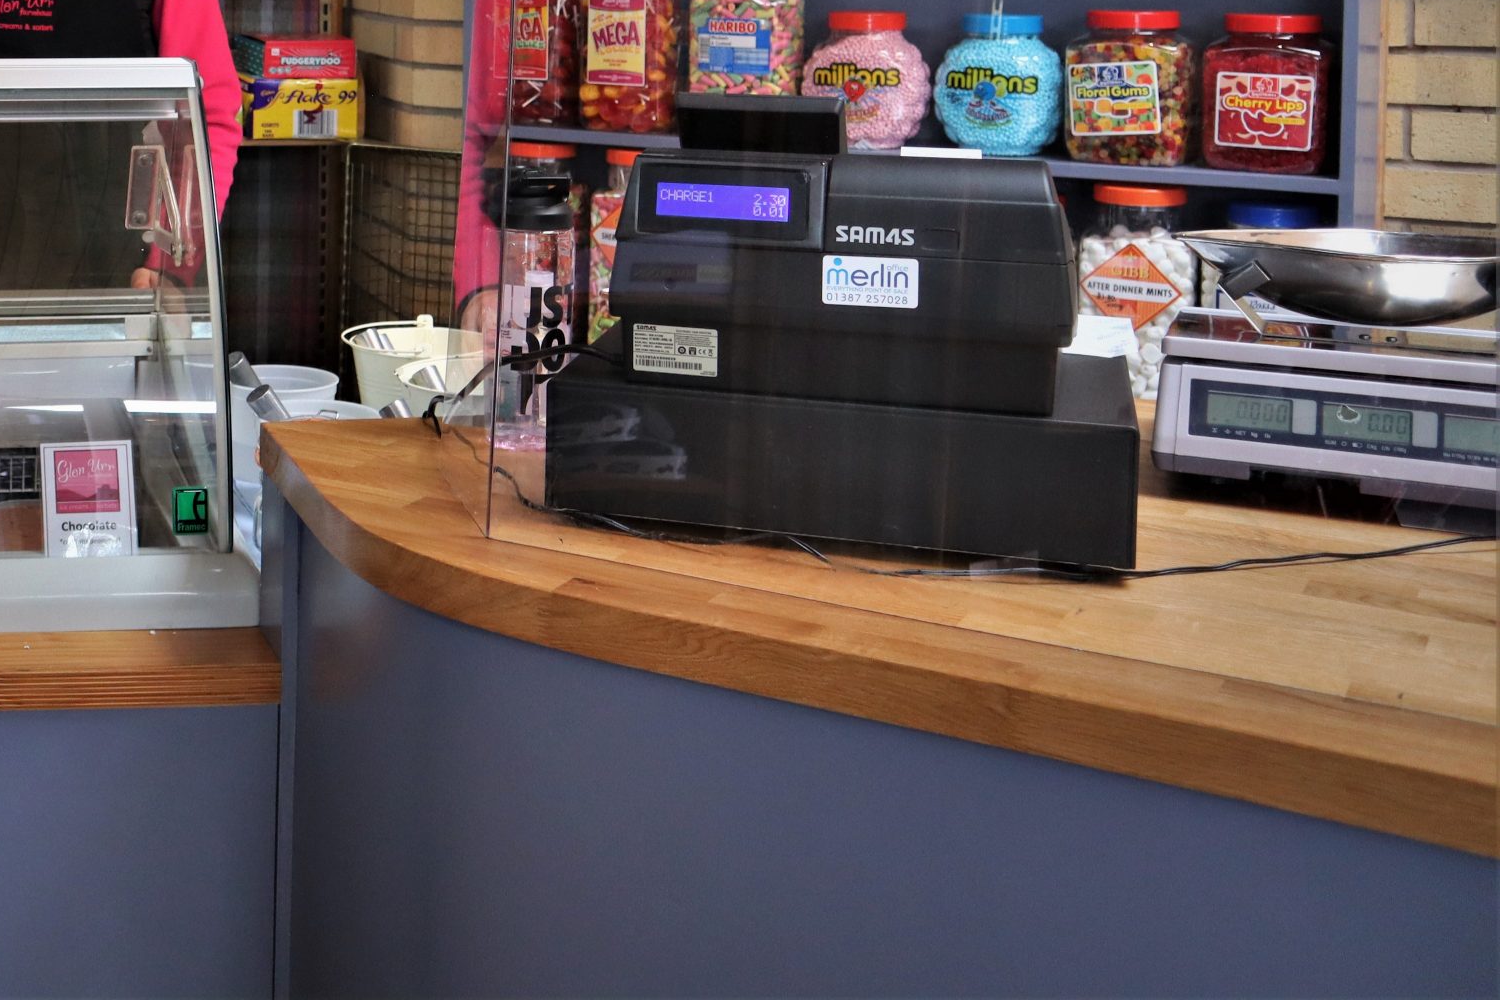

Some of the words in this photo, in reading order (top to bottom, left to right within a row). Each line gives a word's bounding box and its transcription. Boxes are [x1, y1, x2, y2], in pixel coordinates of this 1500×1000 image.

[709, 20, 757, 34] HARIBO
[592, 20, 641, 51] MEGA
[280, 56, 342, 66] FUDGERYDOO
[813, 62, 901, 87] millions
[946, 67, 1038, 95] millions
[337, 90, 358, 105] 99
[1076, 85, 1111, 99] Floral
[1111, 85, 1150, 98] Gums
[1225, 96, 1273, 111] Cherry
[660, 188, 714, 203] CHARGE1
[753, 193, 787, 206] 2.30
[752, 205, 784, 218] 0.01
[835, 225, 915, 246] SAM4S
[826, 259, 909, 289] merlin
[1111, 266, 1150, 279] GIBB
[1087, 282, 1111, 292] AFTER
[1112, 284, 1145, 295] DINNER
[1146, 288, 1173, 299] MINTS
[826, 292, 861, 303] 01387
[866, 294, 909, 305] 257028
[57, 459, 86, 483] Glen
[88, 458, 116, 473] Urr
[61, 521, 117, 532] Chocolate
